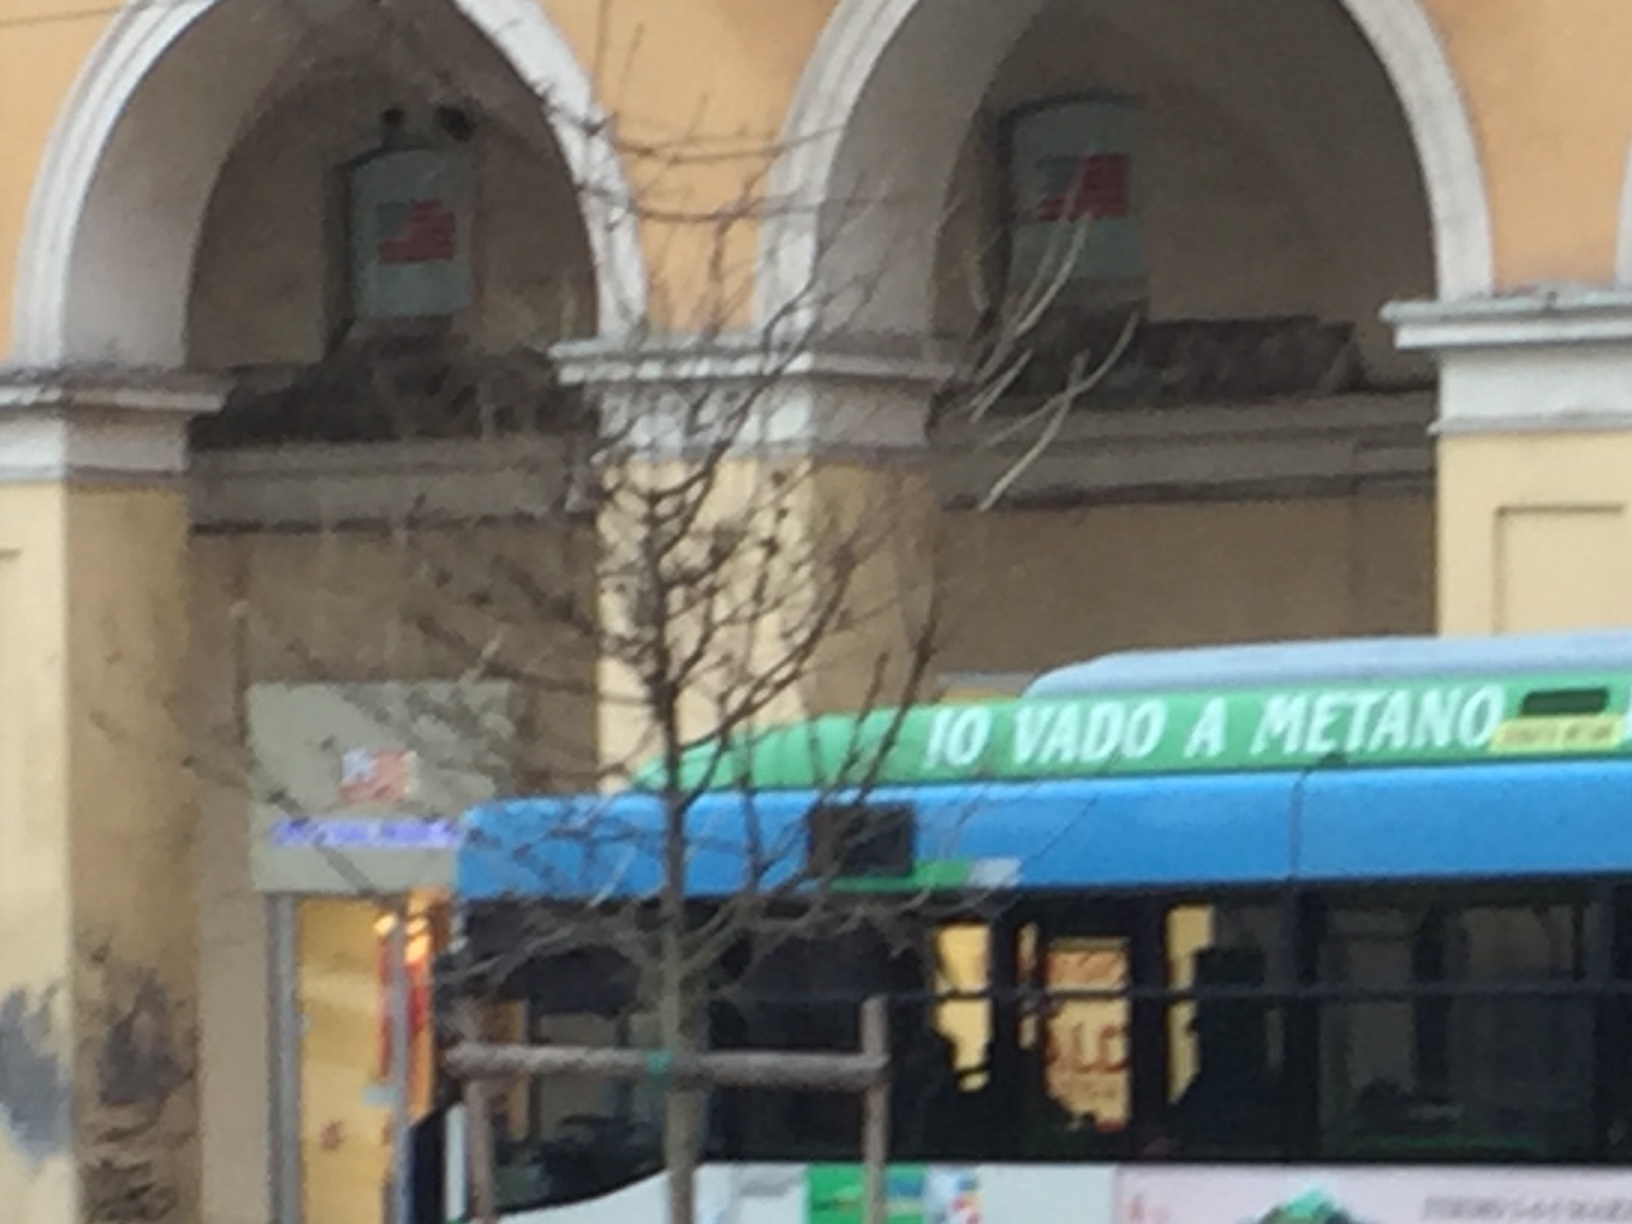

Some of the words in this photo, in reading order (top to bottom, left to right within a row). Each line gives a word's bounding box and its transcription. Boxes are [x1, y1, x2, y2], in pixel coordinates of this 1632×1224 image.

[926, 704, 990, 767] IO
[1013, 700, 1165, 763] VADO
[1184, 698, 1227, 760] A
[1251, 684, 1501, 755] METANO
